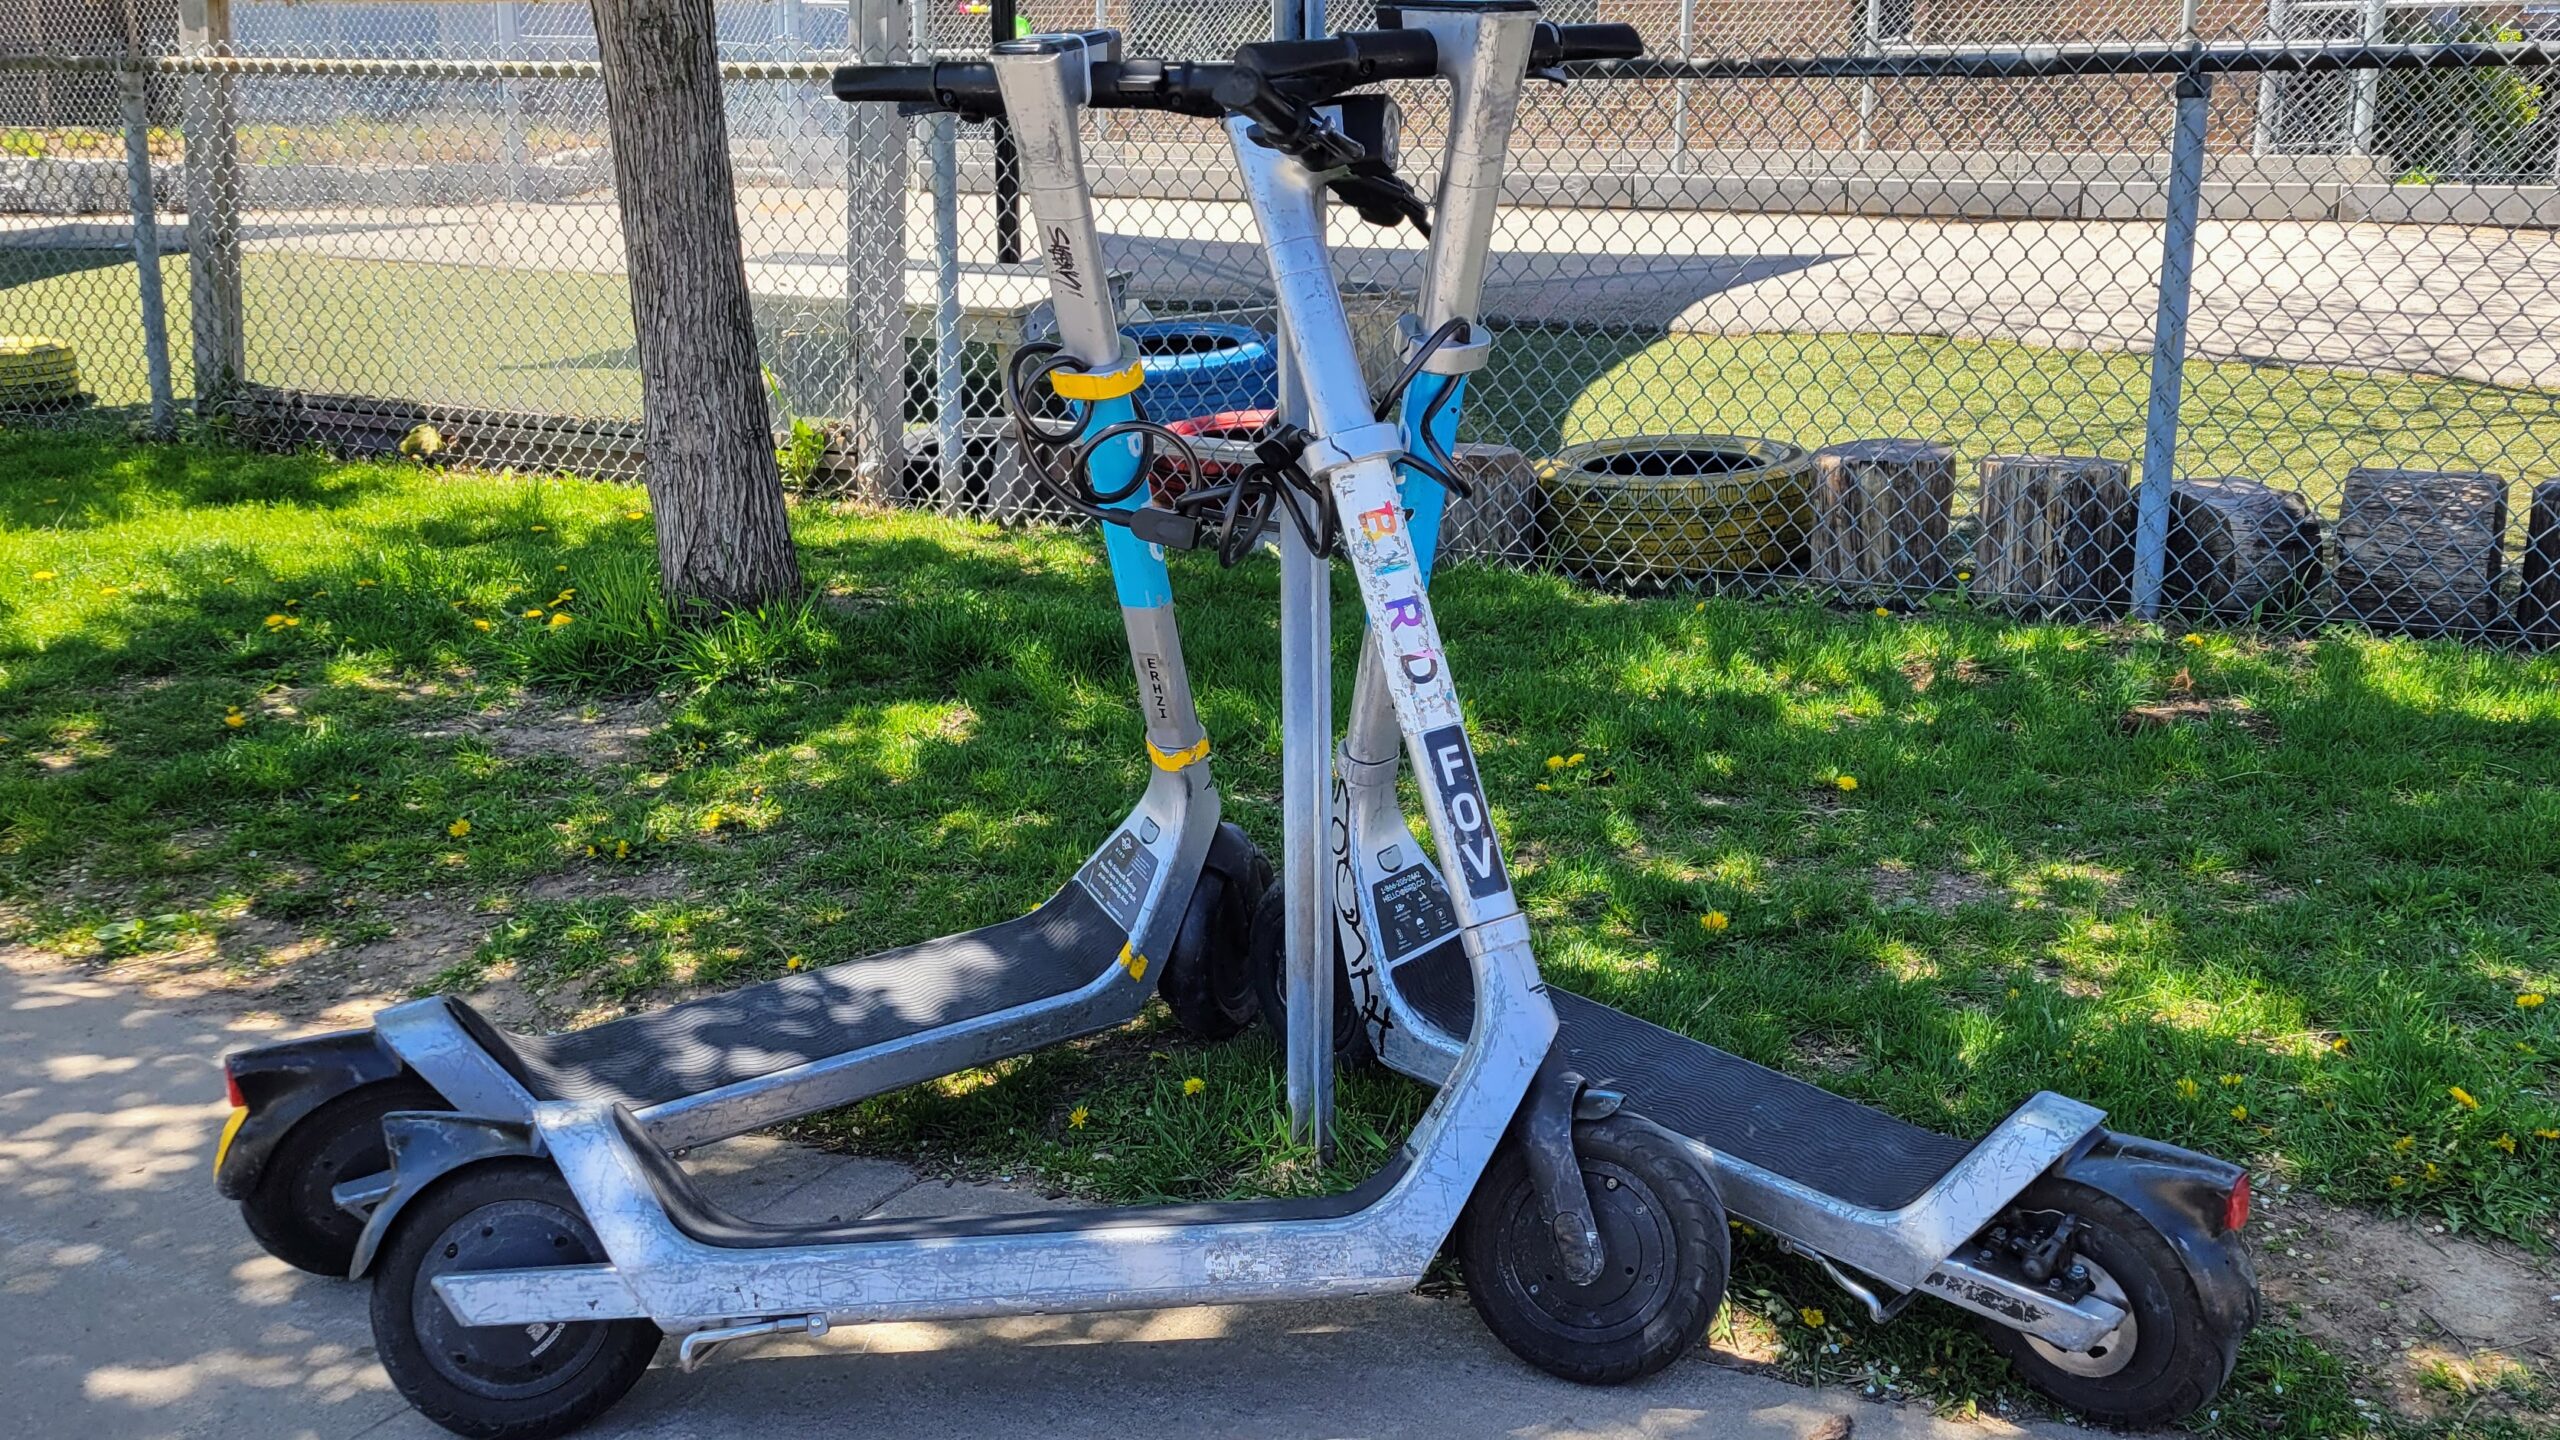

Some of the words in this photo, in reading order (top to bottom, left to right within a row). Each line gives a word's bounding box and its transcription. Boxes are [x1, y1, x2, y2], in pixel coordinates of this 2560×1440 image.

[1358, 500, 1438, 685] BIRD
[1146, 657, 1168, 719] ERHZI
[1437, 743, 1494, 880] FOV
